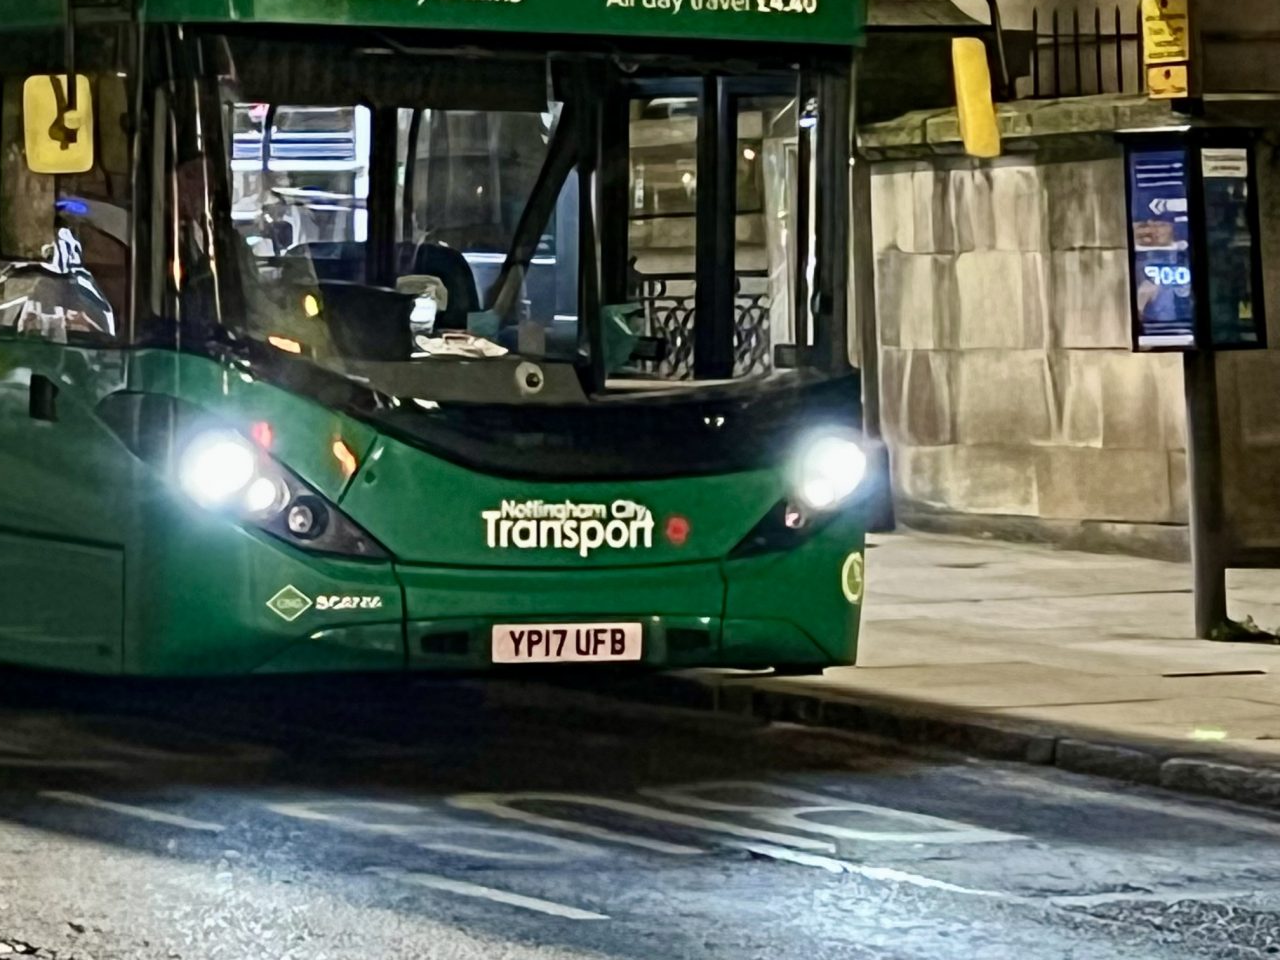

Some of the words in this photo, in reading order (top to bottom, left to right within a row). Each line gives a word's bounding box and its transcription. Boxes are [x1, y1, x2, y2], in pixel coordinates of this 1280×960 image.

[501, 499, 606, 521] Nottingham
[611, 499, 647, 521] City
[482, 509, 655, 558] Transport
[509, 629, 568, 657] YP17
[575, 628, 626, 656] UFB
